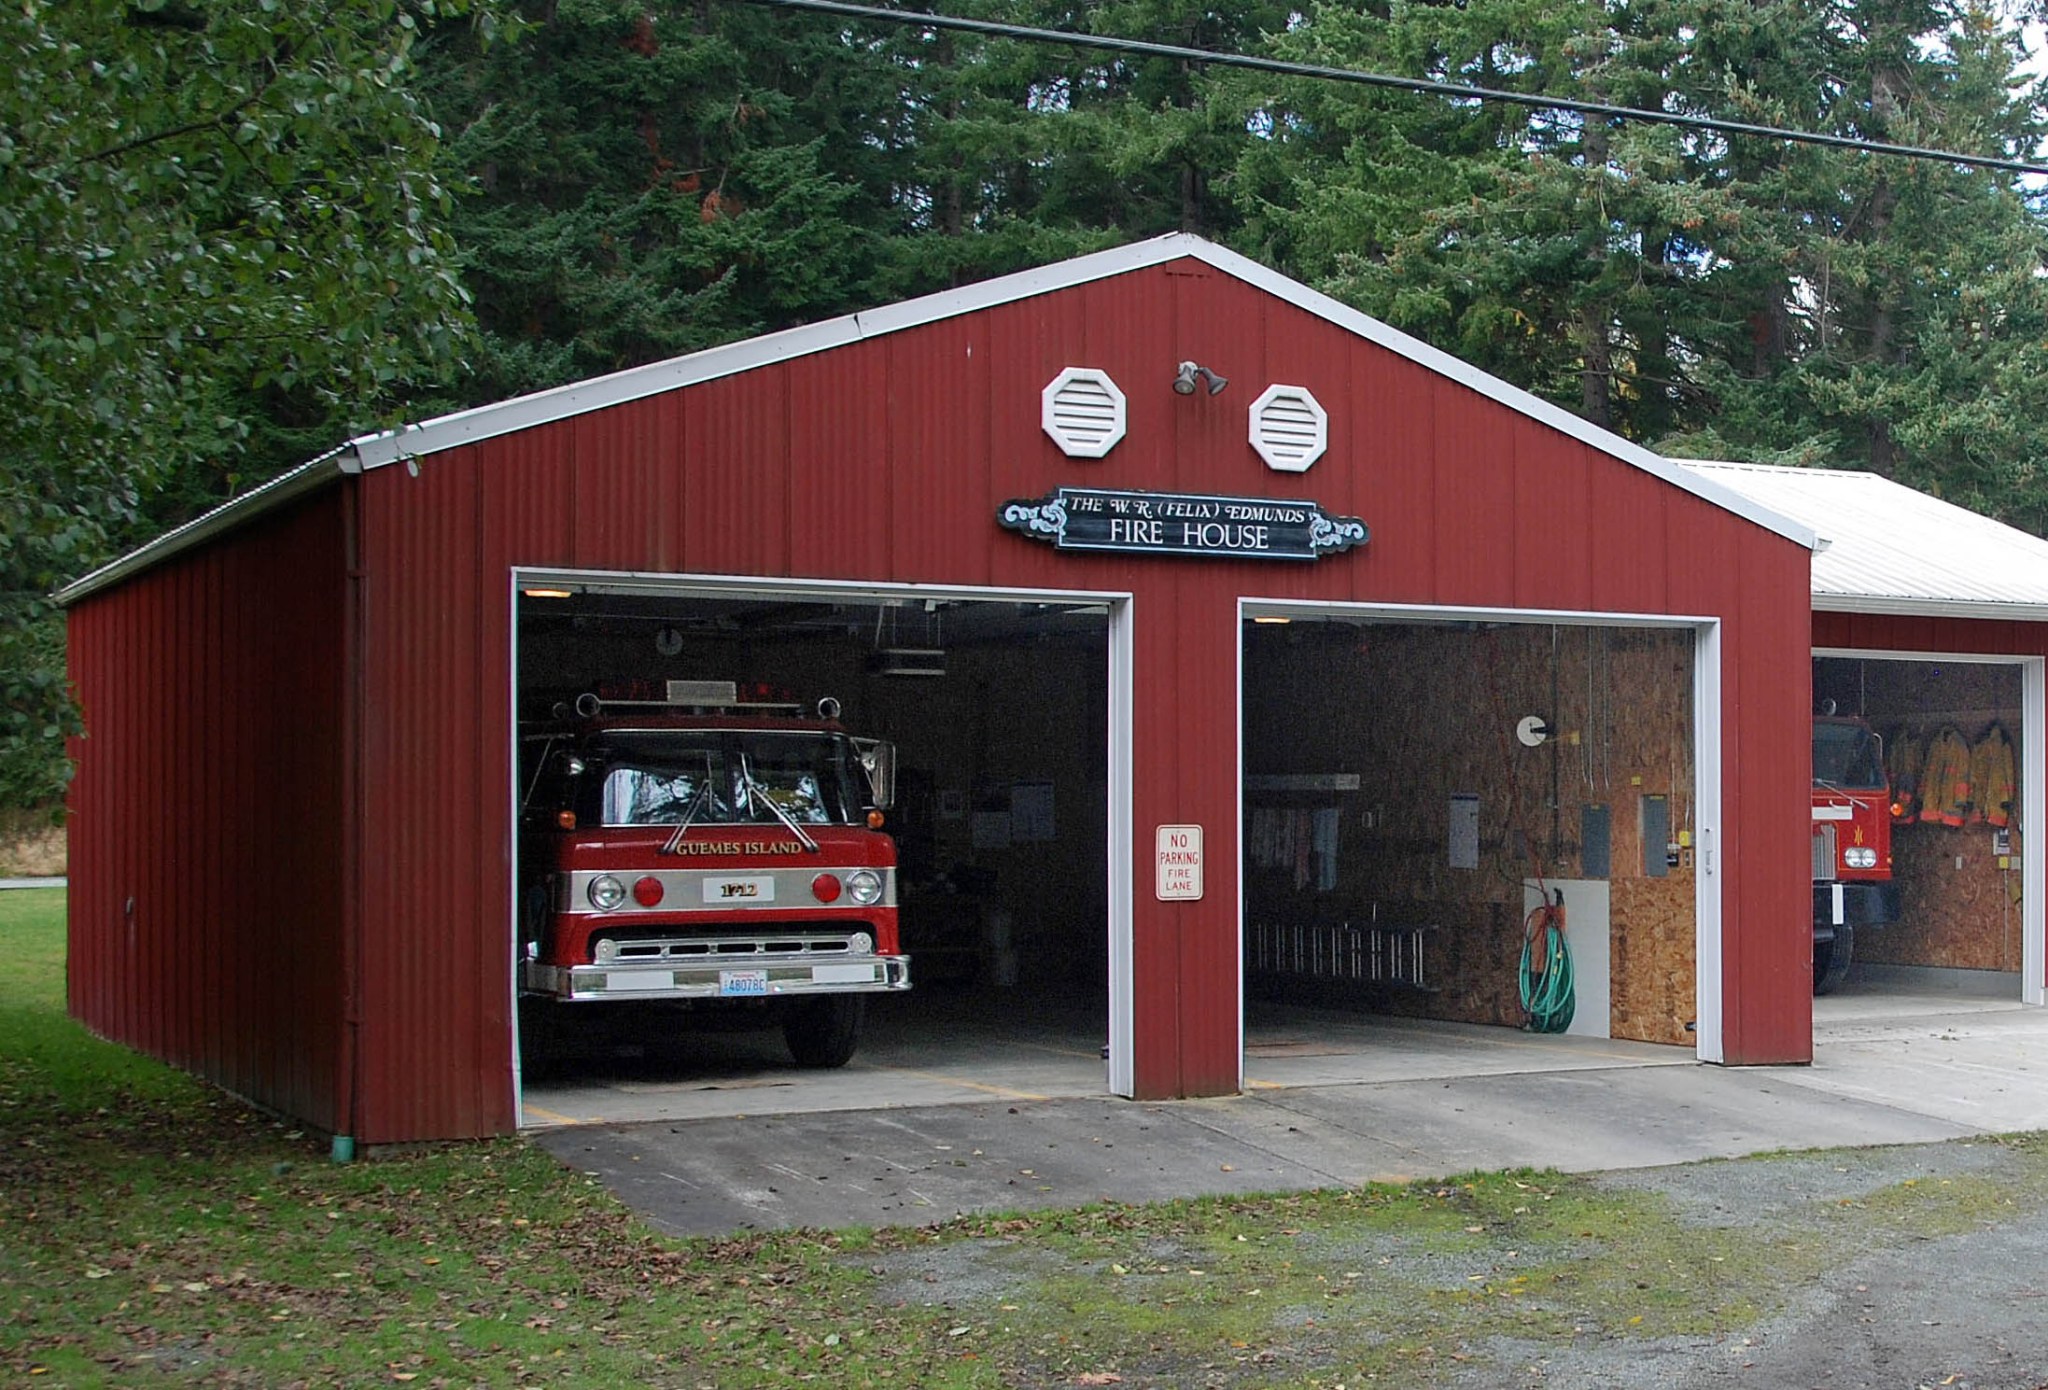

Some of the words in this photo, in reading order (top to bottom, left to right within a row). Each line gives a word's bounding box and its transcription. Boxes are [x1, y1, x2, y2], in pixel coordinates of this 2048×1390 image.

[1071, 497, 1104, 512] THE
[1157, 502, 1220, 519] (FELIX)
[1224, 505, 1306, 523] EDMUNDS
[1110, 518, 1164, 545] FIRE
[1183, 522, 1269, 549] HOUSE
[676, 841, 741, 855] GUEMES
[745, 841, 801, 855] ISLAND
[1170, 834, 1188, 848] NO
[1160, 852, 1199, 865] PARKING
[1168, 869, 1191, 878] FIRE
[1166, 881, 1192, 891] LANE
